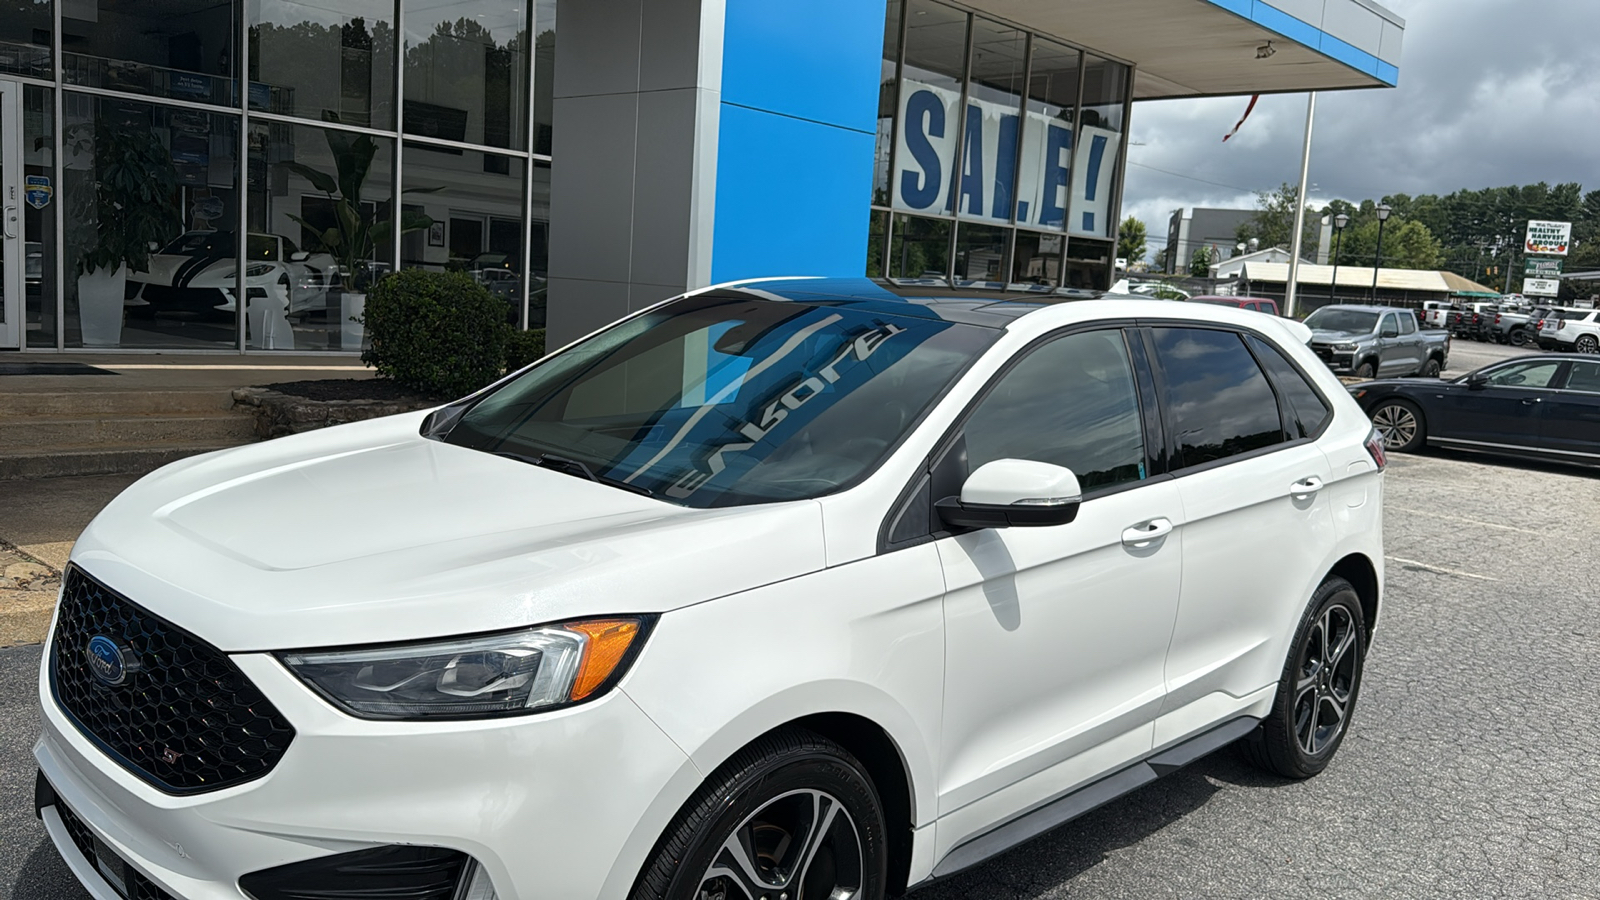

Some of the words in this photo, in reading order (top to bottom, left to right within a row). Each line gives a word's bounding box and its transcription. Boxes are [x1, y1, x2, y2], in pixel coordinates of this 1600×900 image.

[900, 89, 1108, 232] SALE!
[1533, 239, 1567, 247] PRODUCE
[91, 644, 114, 675] Ford
[162, 747, 181, 764] ST
